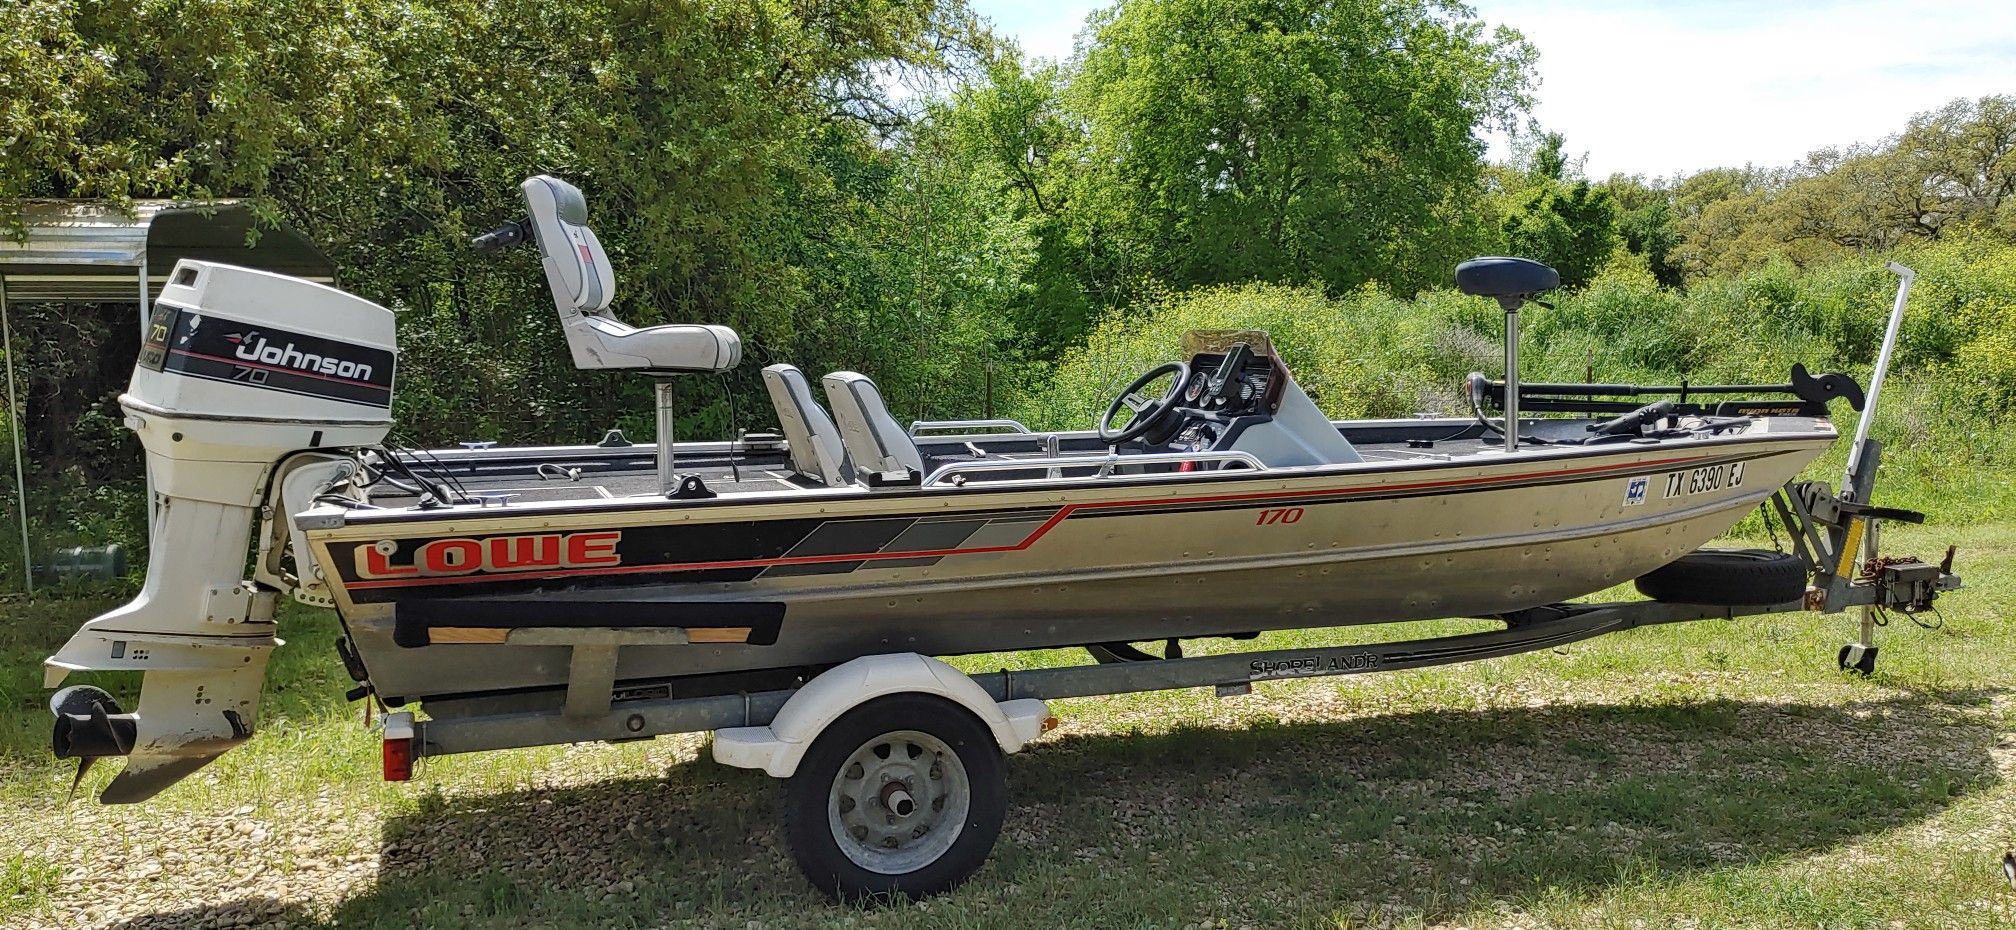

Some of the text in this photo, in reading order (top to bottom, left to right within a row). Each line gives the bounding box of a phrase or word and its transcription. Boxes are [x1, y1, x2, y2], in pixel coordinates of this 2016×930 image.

[151, 323, 168, 342] 70
[235, 337, 373, 381] Johnson
[232, 364, 270, 385] 70
[1665, 472, 1685, 498] TX
[1689, 465, 1724, 494] 6390
[1727, 462, 1746, 488] EJ
[1256, 507, 1305, 526] 170
[357, 532, 621, 579] LOWE
